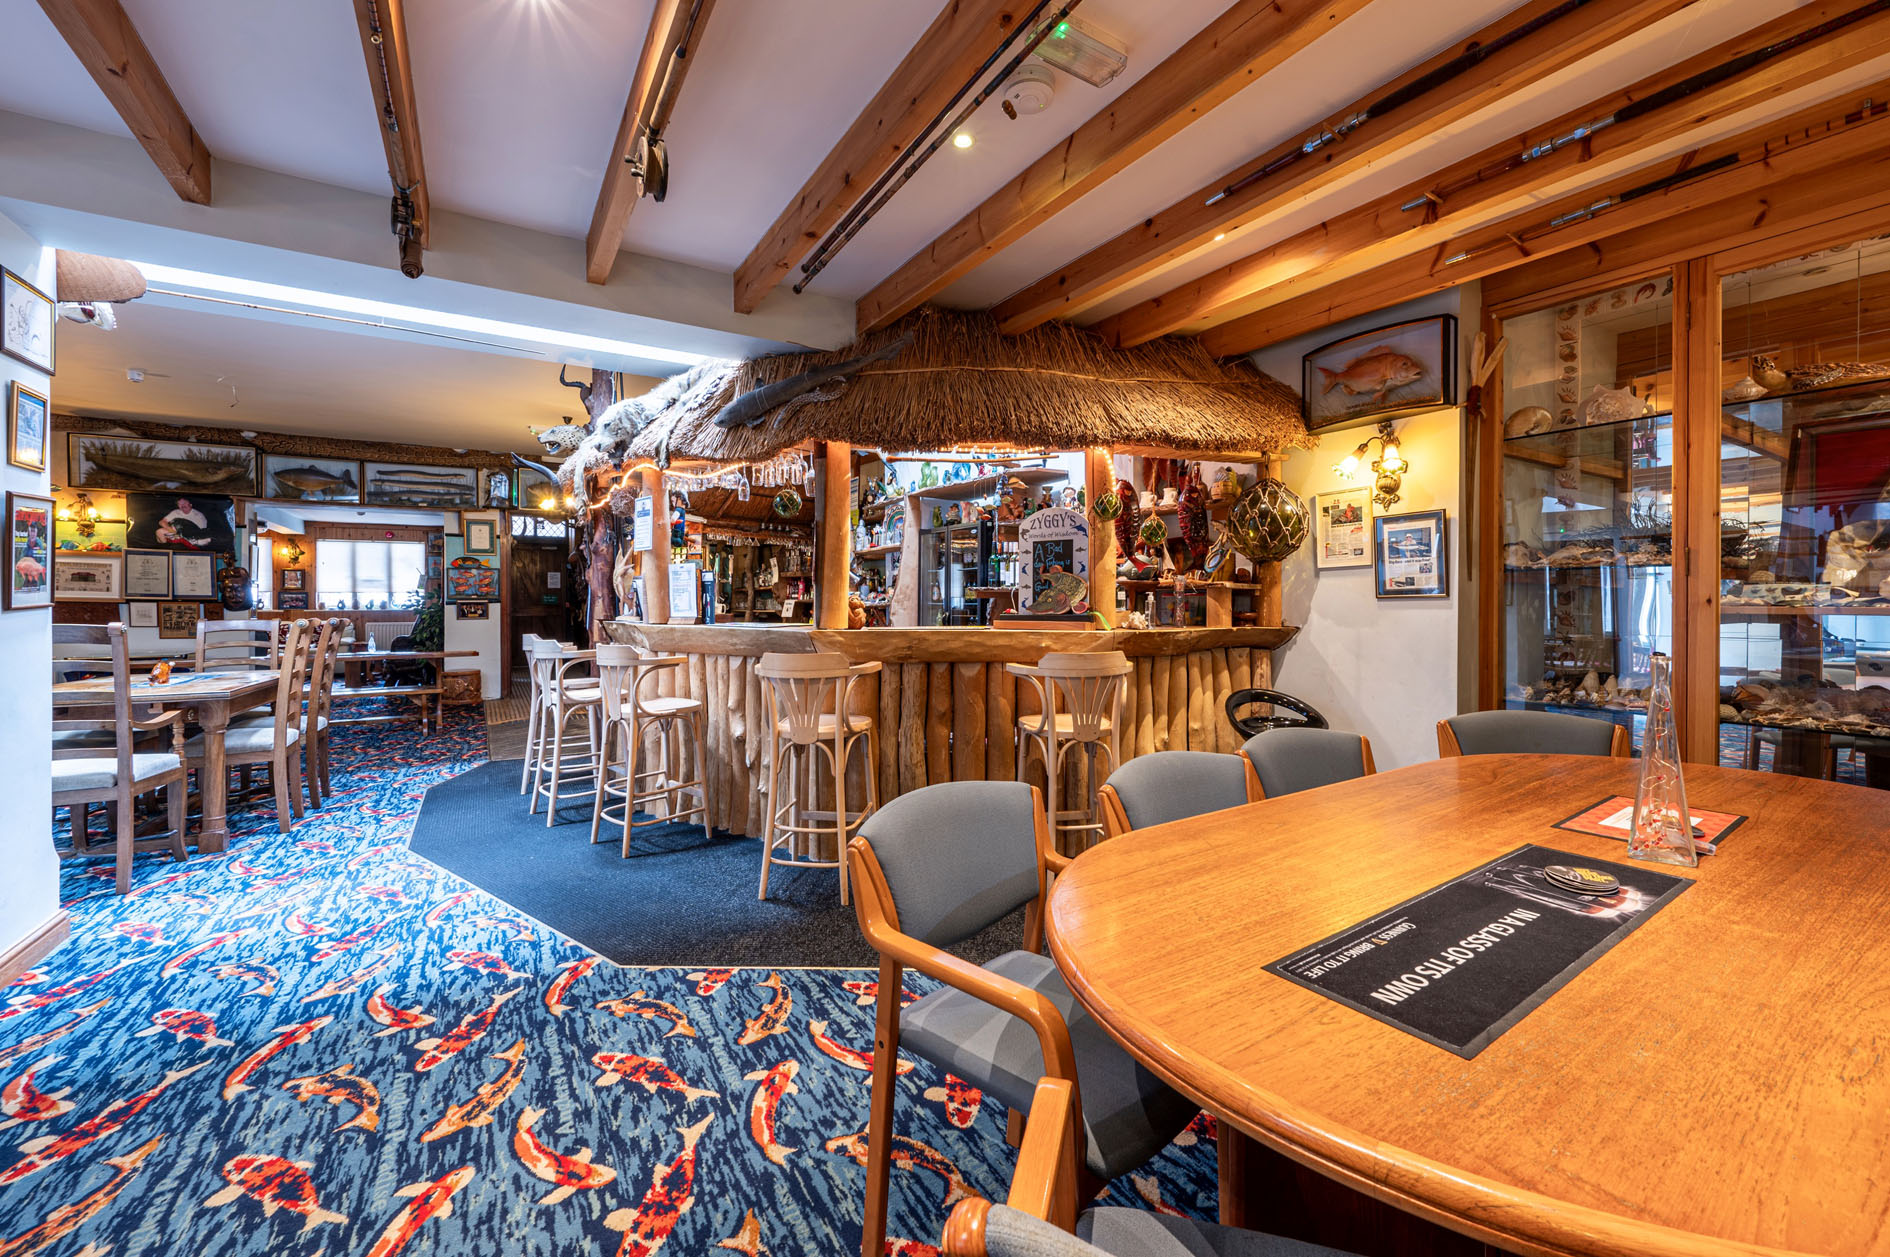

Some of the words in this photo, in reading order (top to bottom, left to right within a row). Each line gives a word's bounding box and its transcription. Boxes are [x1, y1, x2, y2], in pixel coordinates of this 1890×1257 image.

[1030, 512, 1076, 530] ZYGGY'S
[1497, 915, 1527, 927] A
[1508, 907, 1541, 922] IN
[1377, 922, 1417, 941] GUINNESS
[1458, 922, 1516, 952] GLASS
[1335, 954, 1351, 963] IT
[1342, 941, 1376, 959] BRING
[1439, 946, 1475, 966] OF
[1303, 964, 1330, 979] LIFE
[1323, 959, 1343, 969] TO
[1414, 958, 1457, 980] ITS
[1369, 973, 1430, 1006] OWN
